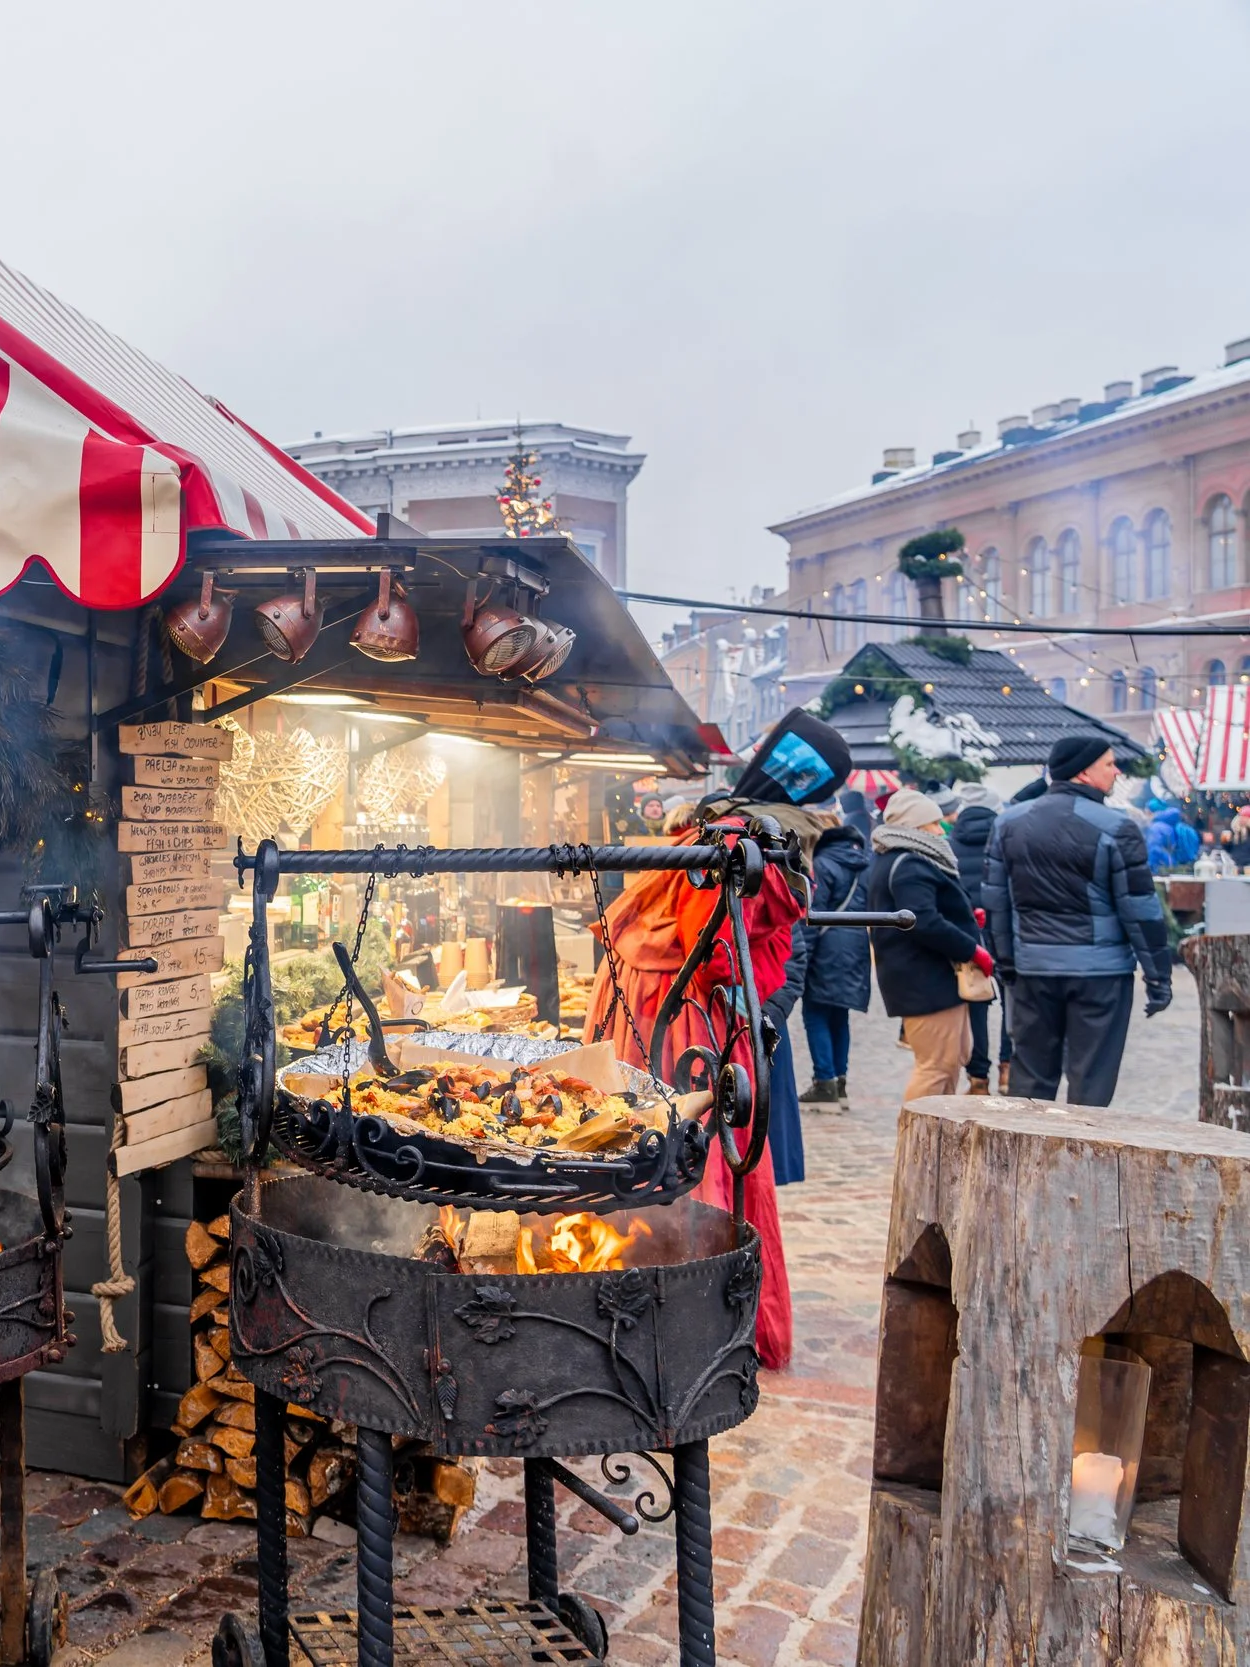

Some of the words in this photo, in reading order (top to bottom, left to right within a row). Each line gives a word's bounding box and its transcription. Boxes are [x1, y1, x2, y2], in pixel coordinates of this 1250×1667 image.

[164, 739, 179, 750] FISH
[143, 803, 161, 815] SOUP
[146, 839, 164, 851] FISH
[173, 837, 194, 849] CHIPS
[142, 915, 175, 933] DORADA
[132, 1024, 149, 1037] FISH
[150, 1021, 172, 1035] SOUP
